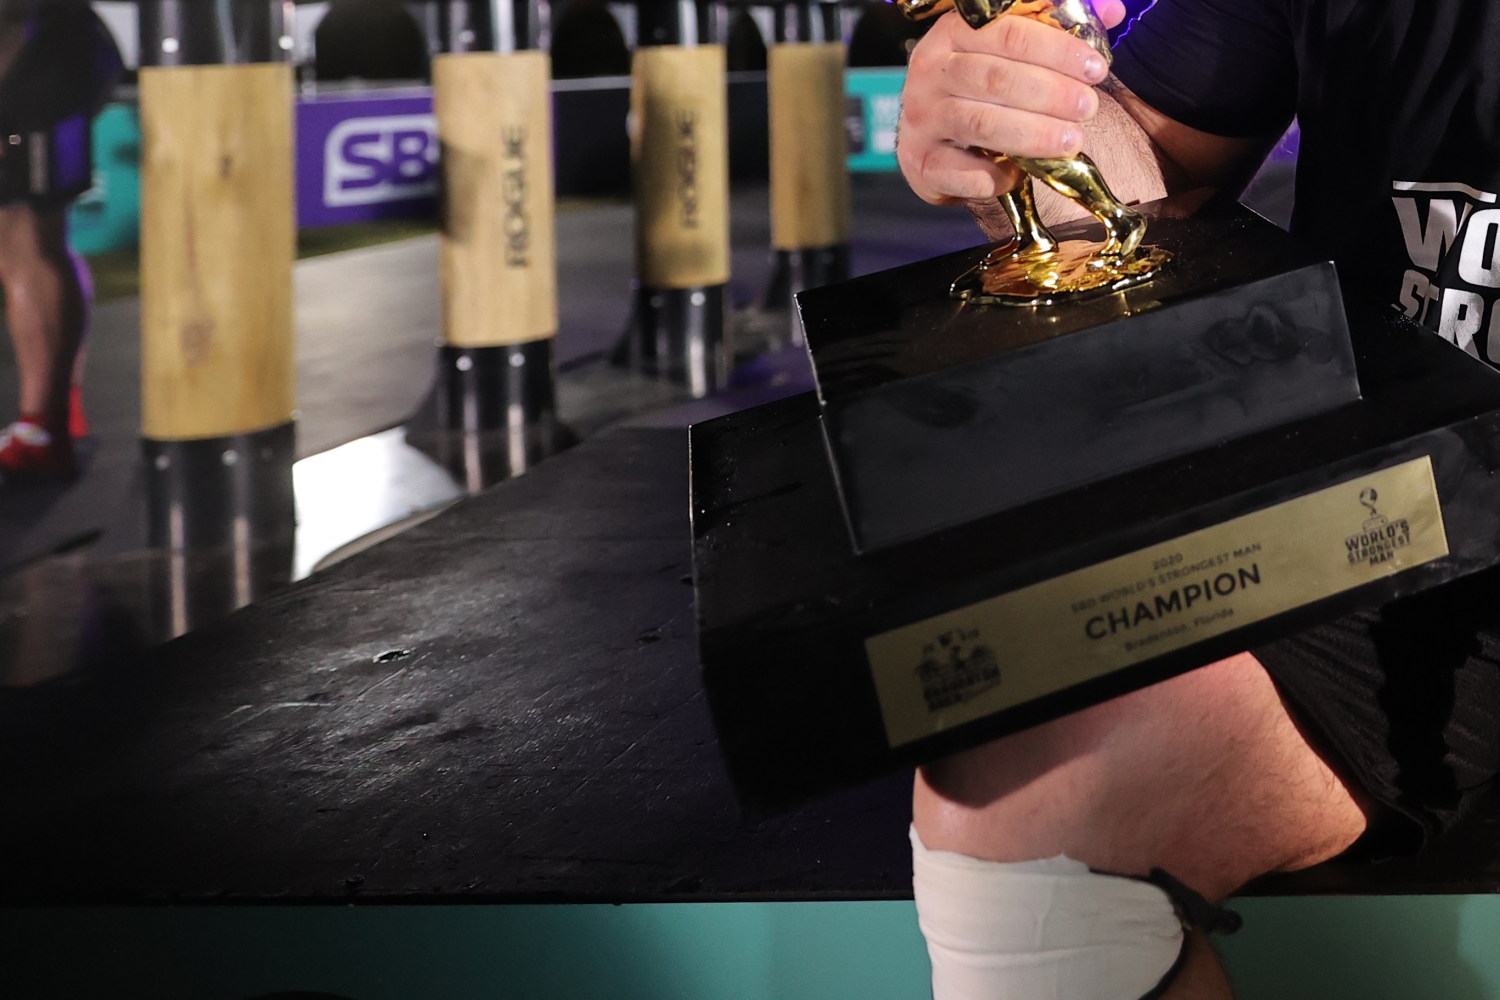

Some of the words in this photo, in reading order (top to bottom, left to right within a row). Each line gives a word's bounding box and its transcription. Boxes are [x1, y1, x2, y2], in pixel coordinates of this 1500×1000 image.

[339, 128, 437, 191] SB
[501, 125, 531, 269] ROGUE
[1152, 552, 1184, 570] 2020
[1344, 519, 1410, 552] WORLD'S
[1085, 563, 1261, 640] CHAMPION
[1100, 577, 1156, 603] WORLD'S
[1158, 553, 1230, 584] STRONGEST
[1233, 542, 1262, 559] MAN
[1193, 607, 1235, 628] Florida
